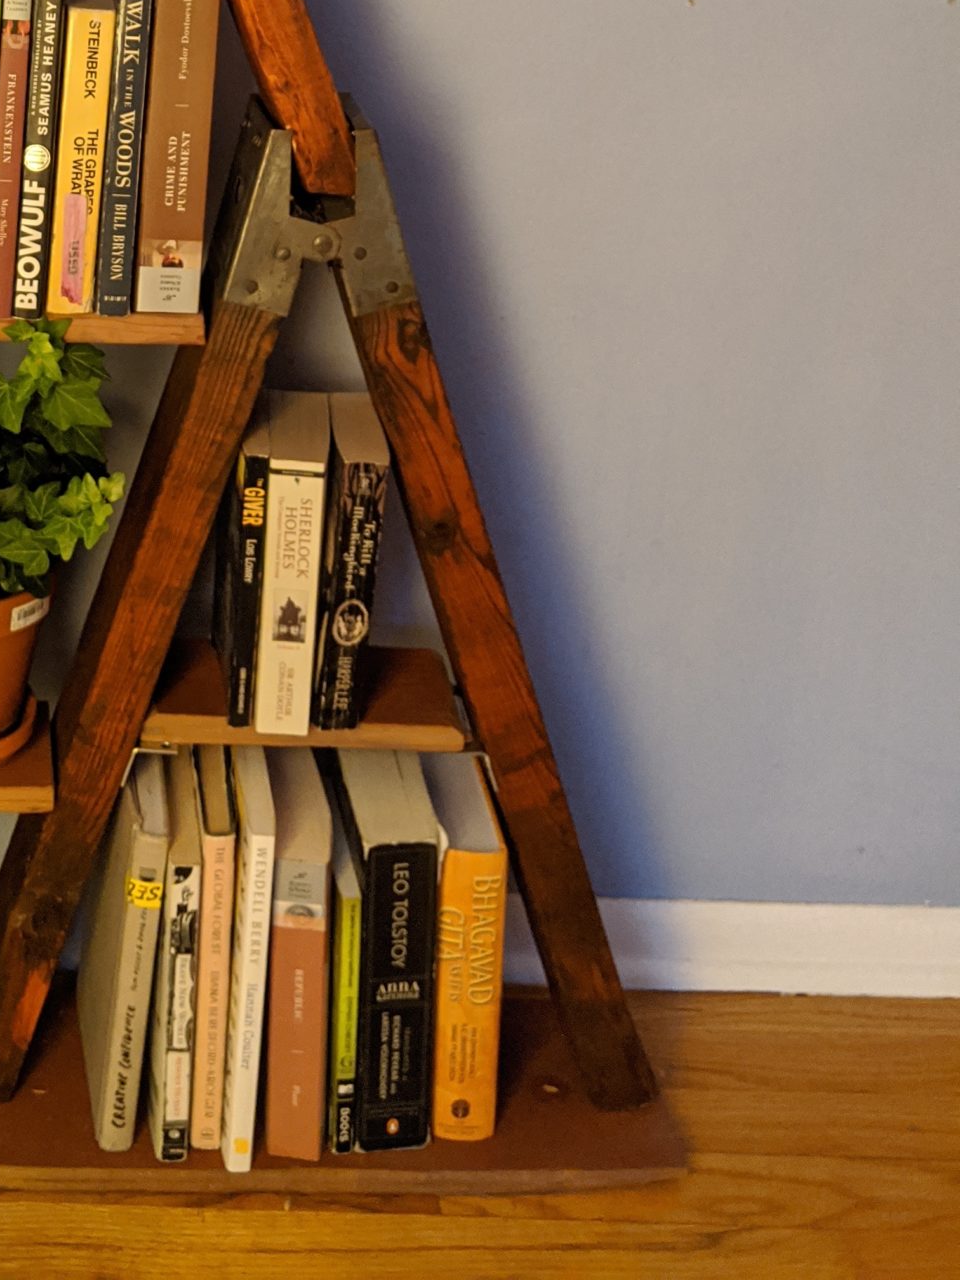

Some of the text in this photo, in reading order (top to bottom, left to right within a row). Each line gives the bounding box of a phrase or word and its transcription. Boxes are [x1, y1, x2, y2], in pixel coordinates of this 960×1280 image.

[41, 1, 58, 66] HEANEY
[83, 20, 102, 99] STEINBECK
[122, 0, 145, 65] WALK
[178, 46, 190, 80] Fyodor
[36, 72, 53, 136] SEAMUS
[124, 84, 134, 108] THE
[125, 68, 135, 82] IN
[2, 73, 17, 163] FRANKENSTEIN
[72, 135, 86, 157] OF
[85, 128, 100, 156] THE
[114, 110, 137, 189] WOODS
[164, 136, 179, 207] CRIME AND
[176, 131, 191, 212] PUNISHMENT
[14, 179, 47, 311] BEOWULF
[112, 203, 128, 231] BILL
[109, 233, 126, 281] BRYSON
[242, 487, 266, 527] GIVER
[282, 506, 298, 570] HOLMES
[295, 497, 313, 579] SHERLOCK
[363, 520, 377, 537] To
[342, 506, 365, 592] Mockingbird
[360, 539, 375, 564] Kill
[211, 847, 226, 955] THE GLOBAL FOREST
[248, 847, 268, 964] WENDELL BERRY
[390, 862, 410, 969] LEO TOLSTOY
[440, 905, 466, 961] GITA
[467, 875, 502, 1005] BHAGAVAD
[240, 983, 258, 1070] Hannah Coulter
[111, 1005, 136, 1129] CREATIVE CONFIDENCE
